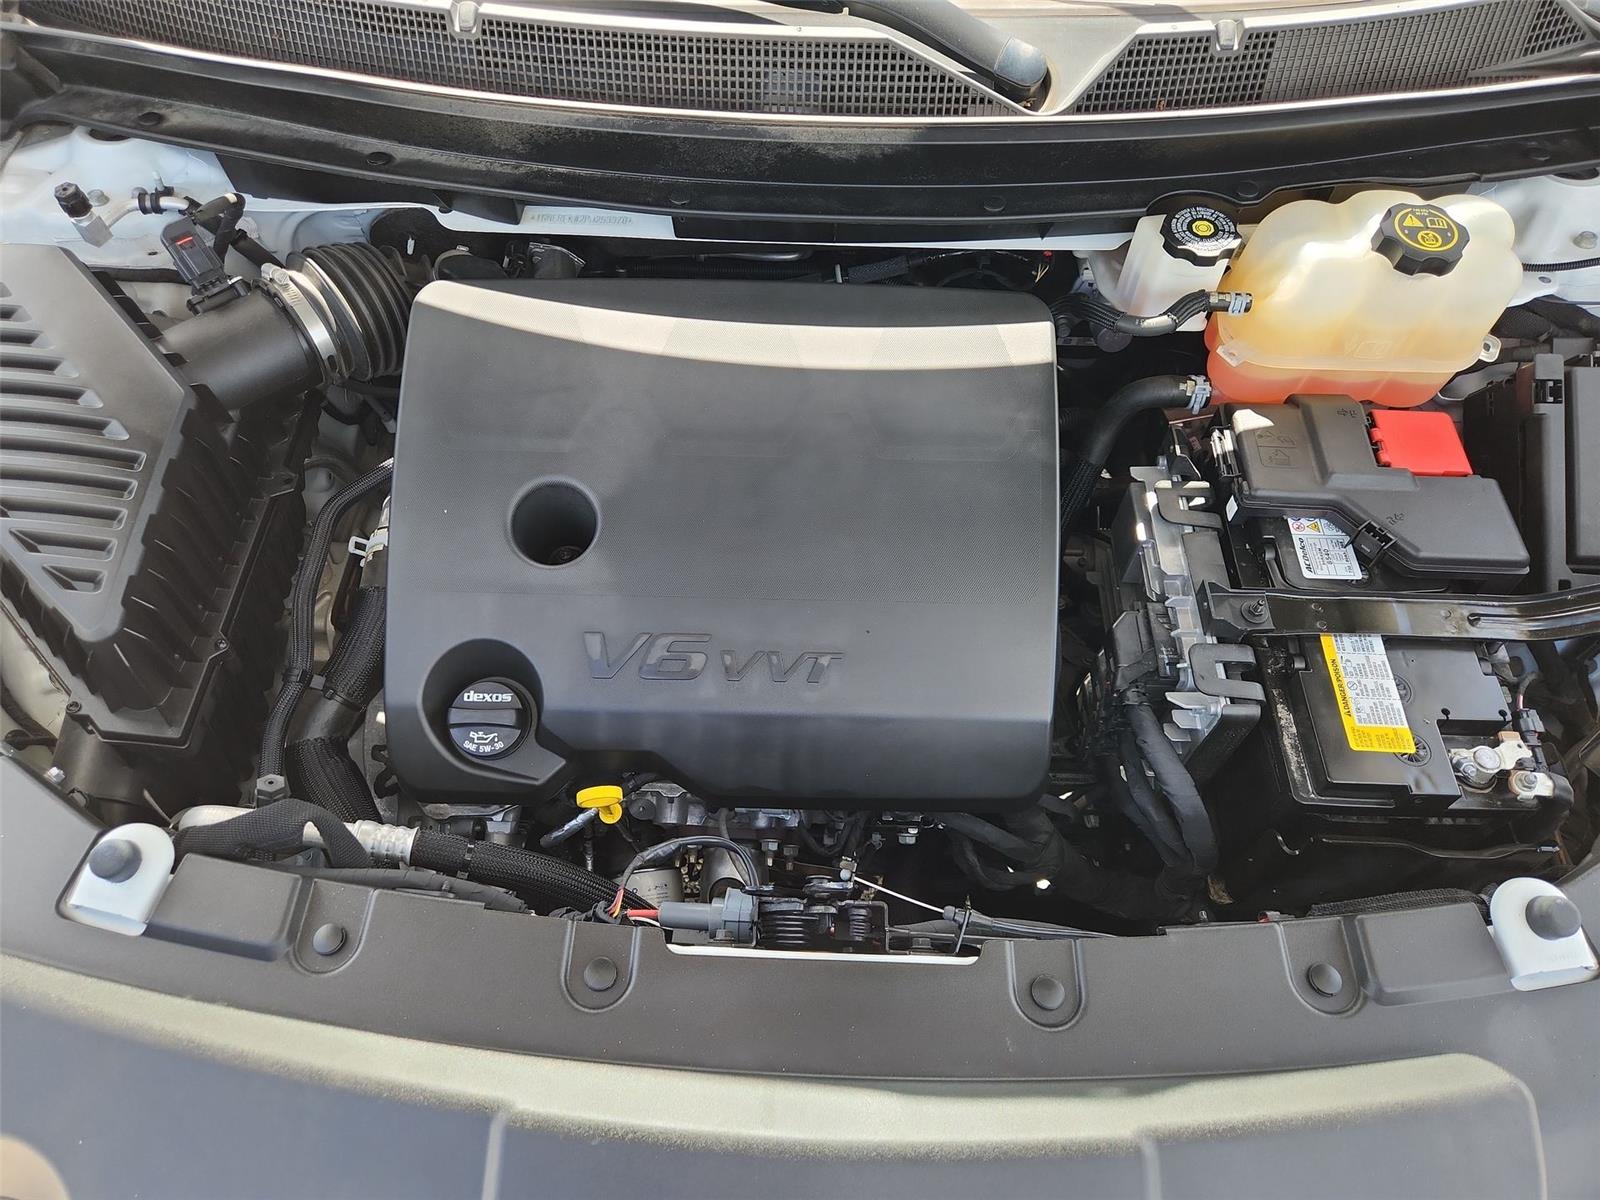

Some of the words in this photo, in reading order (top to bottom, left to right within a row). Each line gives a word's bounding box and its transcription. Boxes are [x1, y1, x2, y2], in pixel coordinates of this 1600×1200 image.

[1298, 537, 1313, 573] ACDelco
[583, 631, 712, 680] V6
[720, 650, 844, 684] VVT
[463, 690, 514, 702] dexos
[463, 740, 478, 752] SAE
[479, 741, 505, 753] 5W-30
